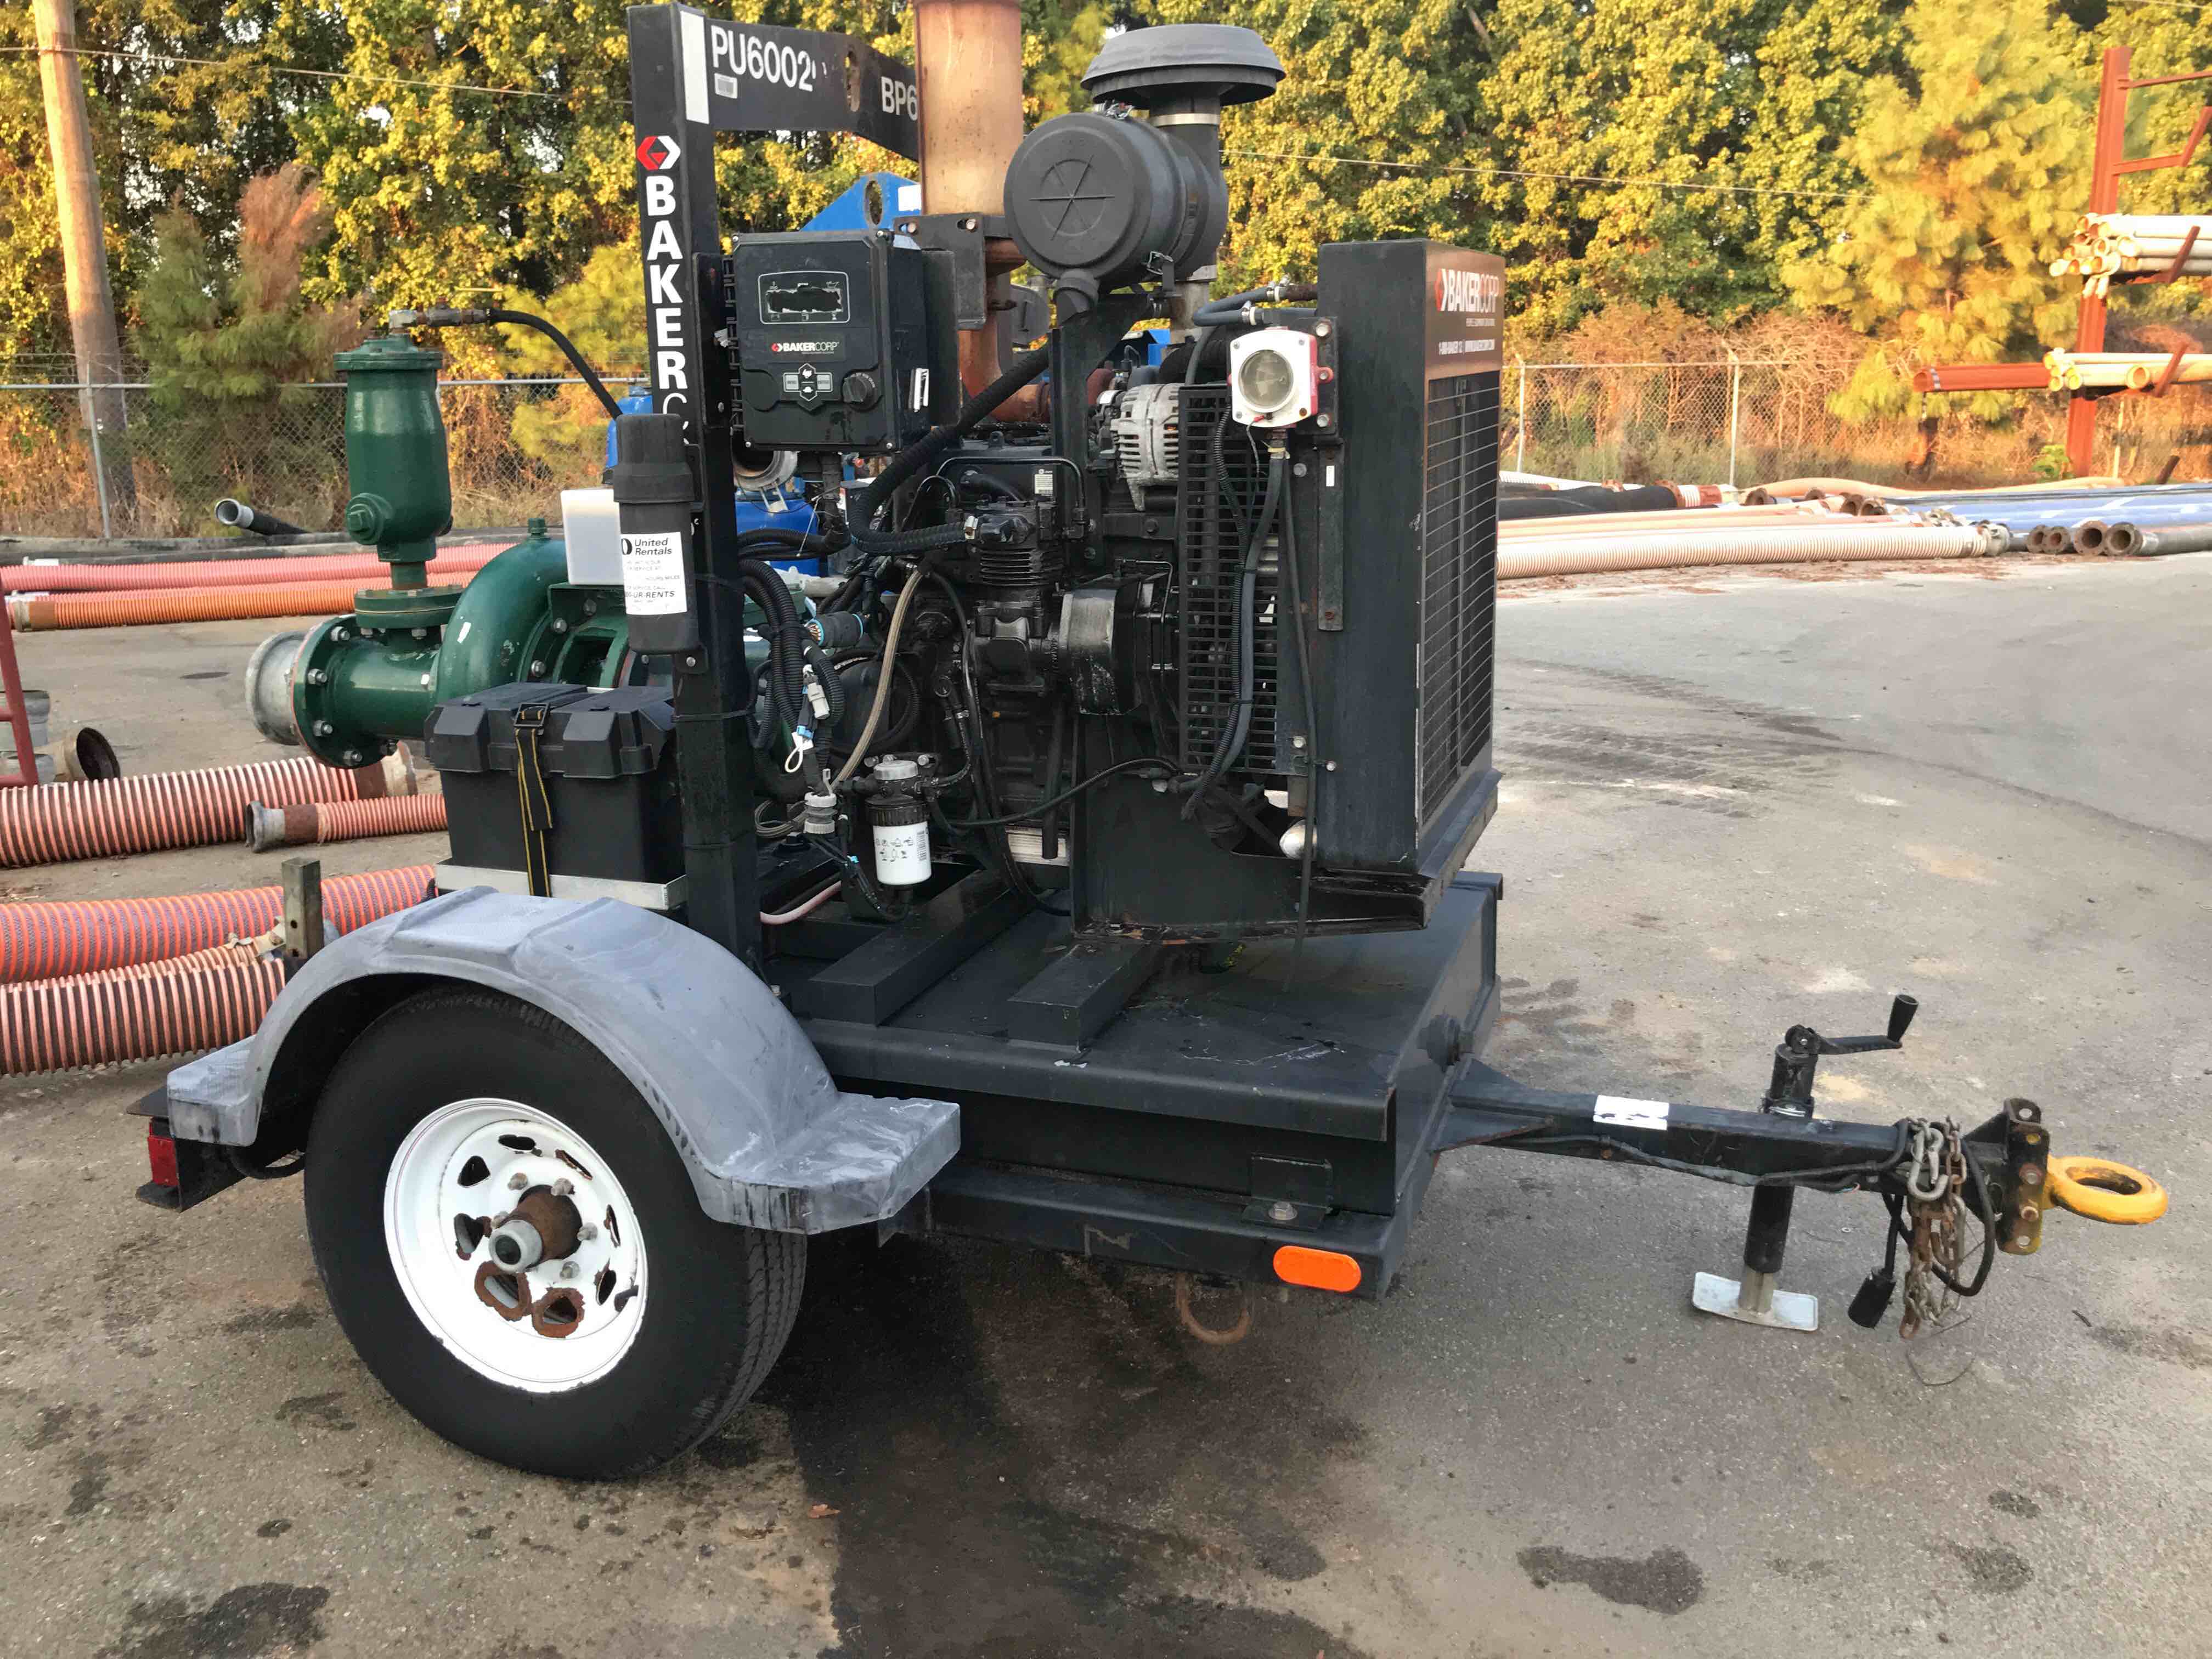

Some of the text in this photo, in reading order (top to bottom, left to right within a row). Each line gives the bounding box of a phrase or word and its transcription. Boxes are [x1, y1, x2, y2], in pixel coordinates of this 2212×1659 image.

[711, 25, 827, 92] PU6002
[635, 537, 669, 546] United
[635, 547, 672, 556] Rentals
